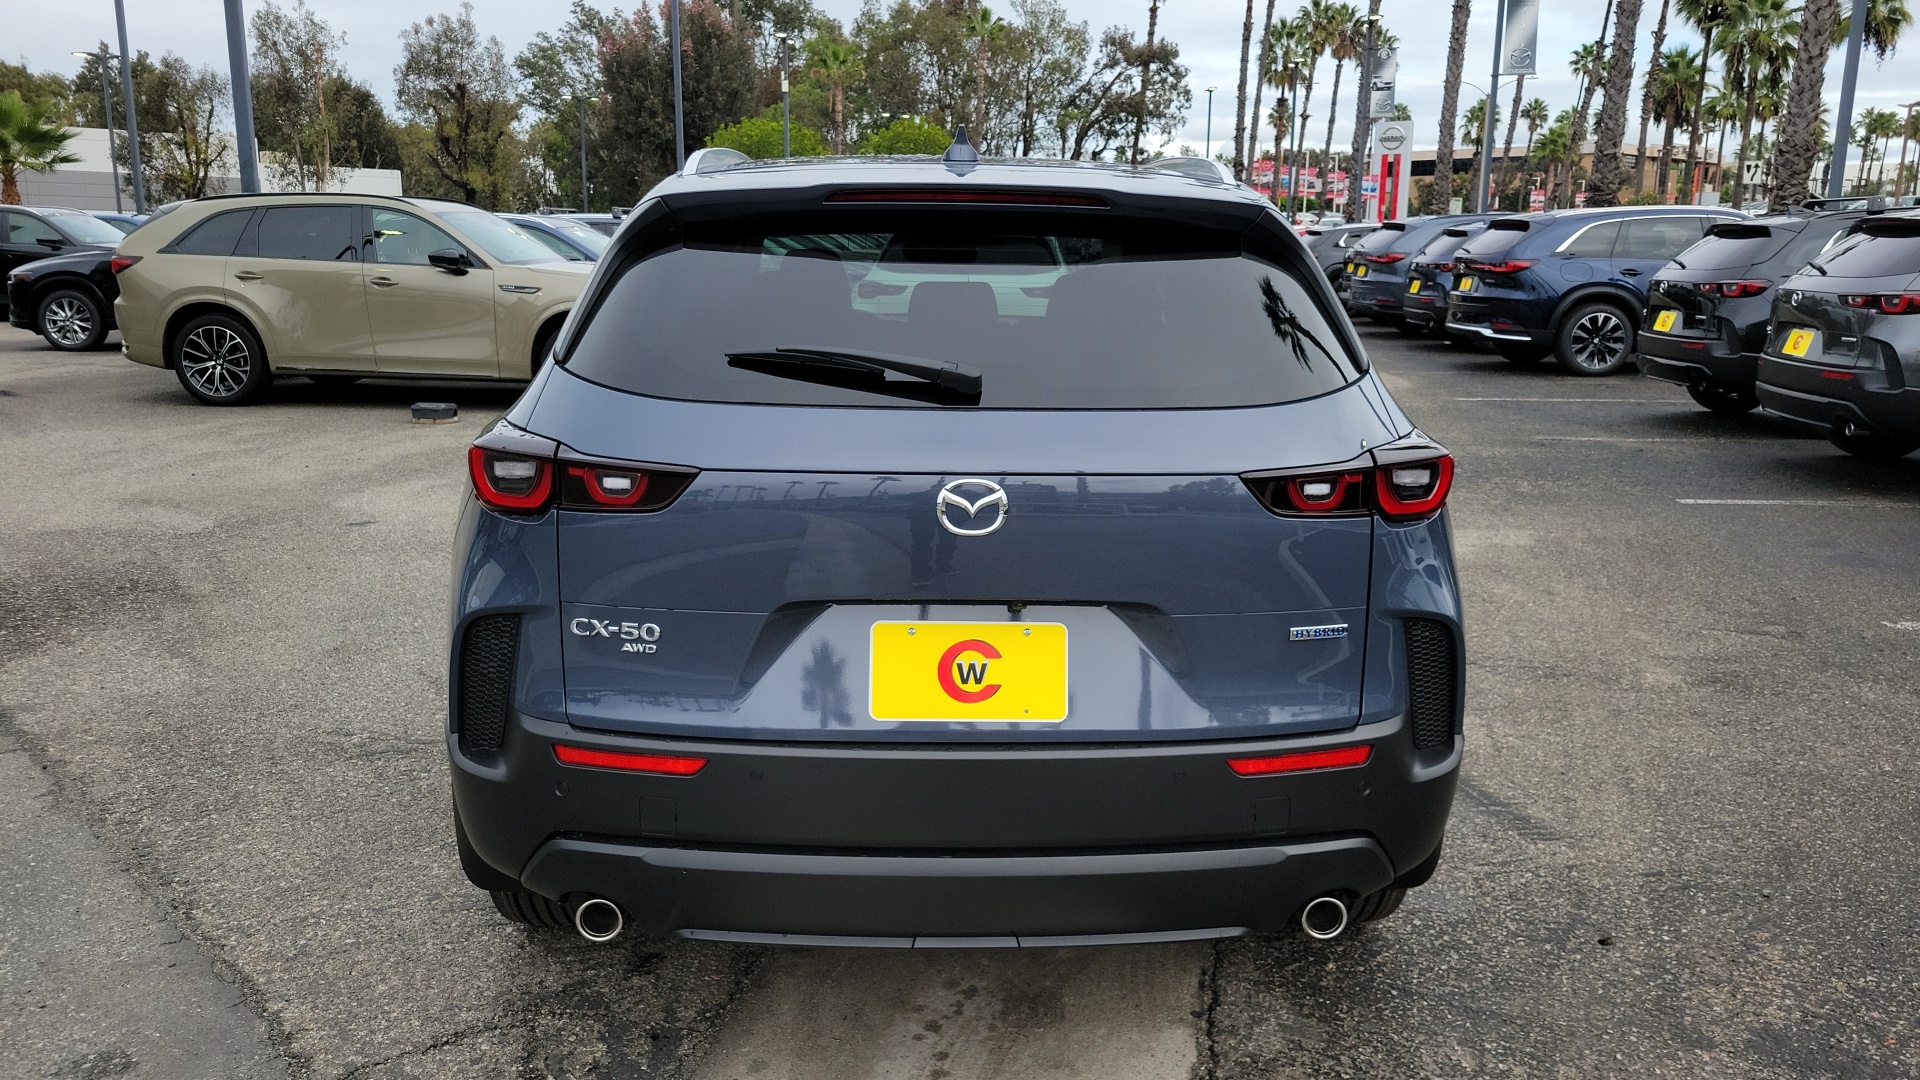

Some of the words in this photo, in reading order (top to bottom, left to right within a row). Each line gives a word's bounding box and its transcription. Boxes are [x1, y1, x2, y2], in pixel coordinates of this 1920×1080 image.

[570, 618, 661, 642] CX-50
[1295, 627, 1345, 639] HYBRID
[621, 643, 657, 654] AWD
